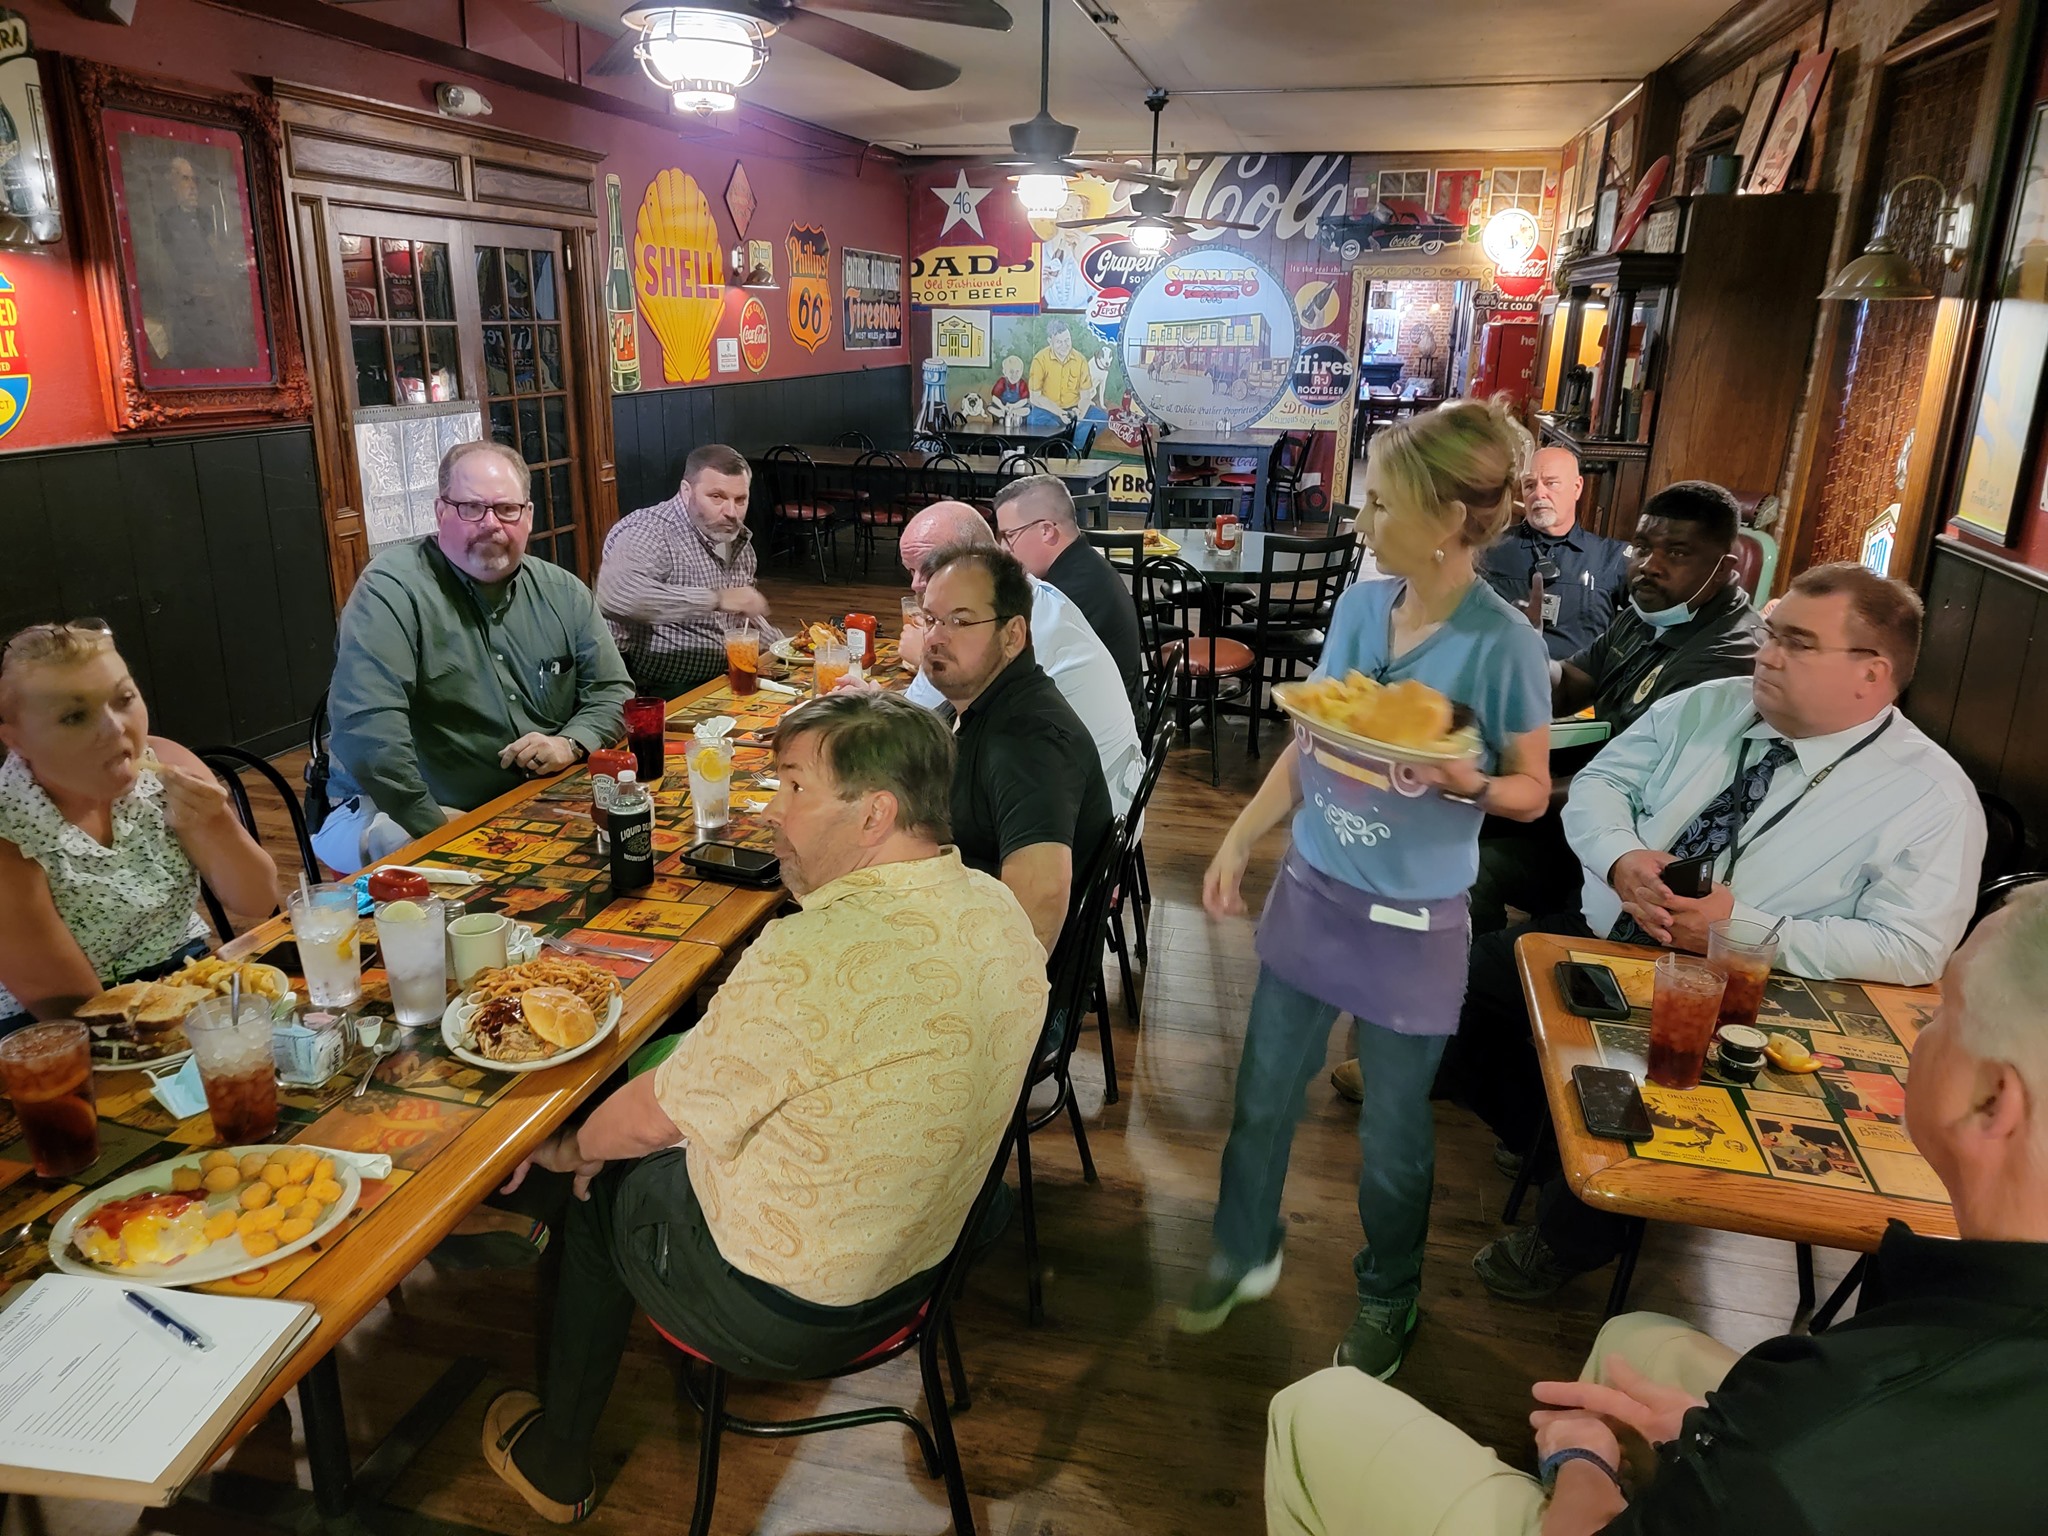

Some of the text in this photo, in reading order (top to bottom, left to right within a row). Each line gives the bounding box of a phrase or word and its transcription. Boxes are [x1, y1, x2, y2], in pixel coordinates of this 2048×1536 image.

[953, 191, 971, 215] 46
[790, 236, 826, 282] Phillips
[643, 244, 720, 299] SHELL
[924, 276, 1003, 290] Old Fashioned
[968, 287, 1017, 299] BEER
[799, 287, 822, 334] 66
[845, 287, 901, 335] Firestone
[1511, 302, 1533, 311] COLD
[1294, 353, 1354, 376] Hires
[1297, 385, 1344, 395] ROOT BEER
[620, 821, 652, 842] LIQUID DEA
[1871, 1051, 1903, 1060] NOTRE
[1666, 1093, 1719, 1105] OKLAHOMA
[1677, 1104, 1718, 1115] INDIANA
